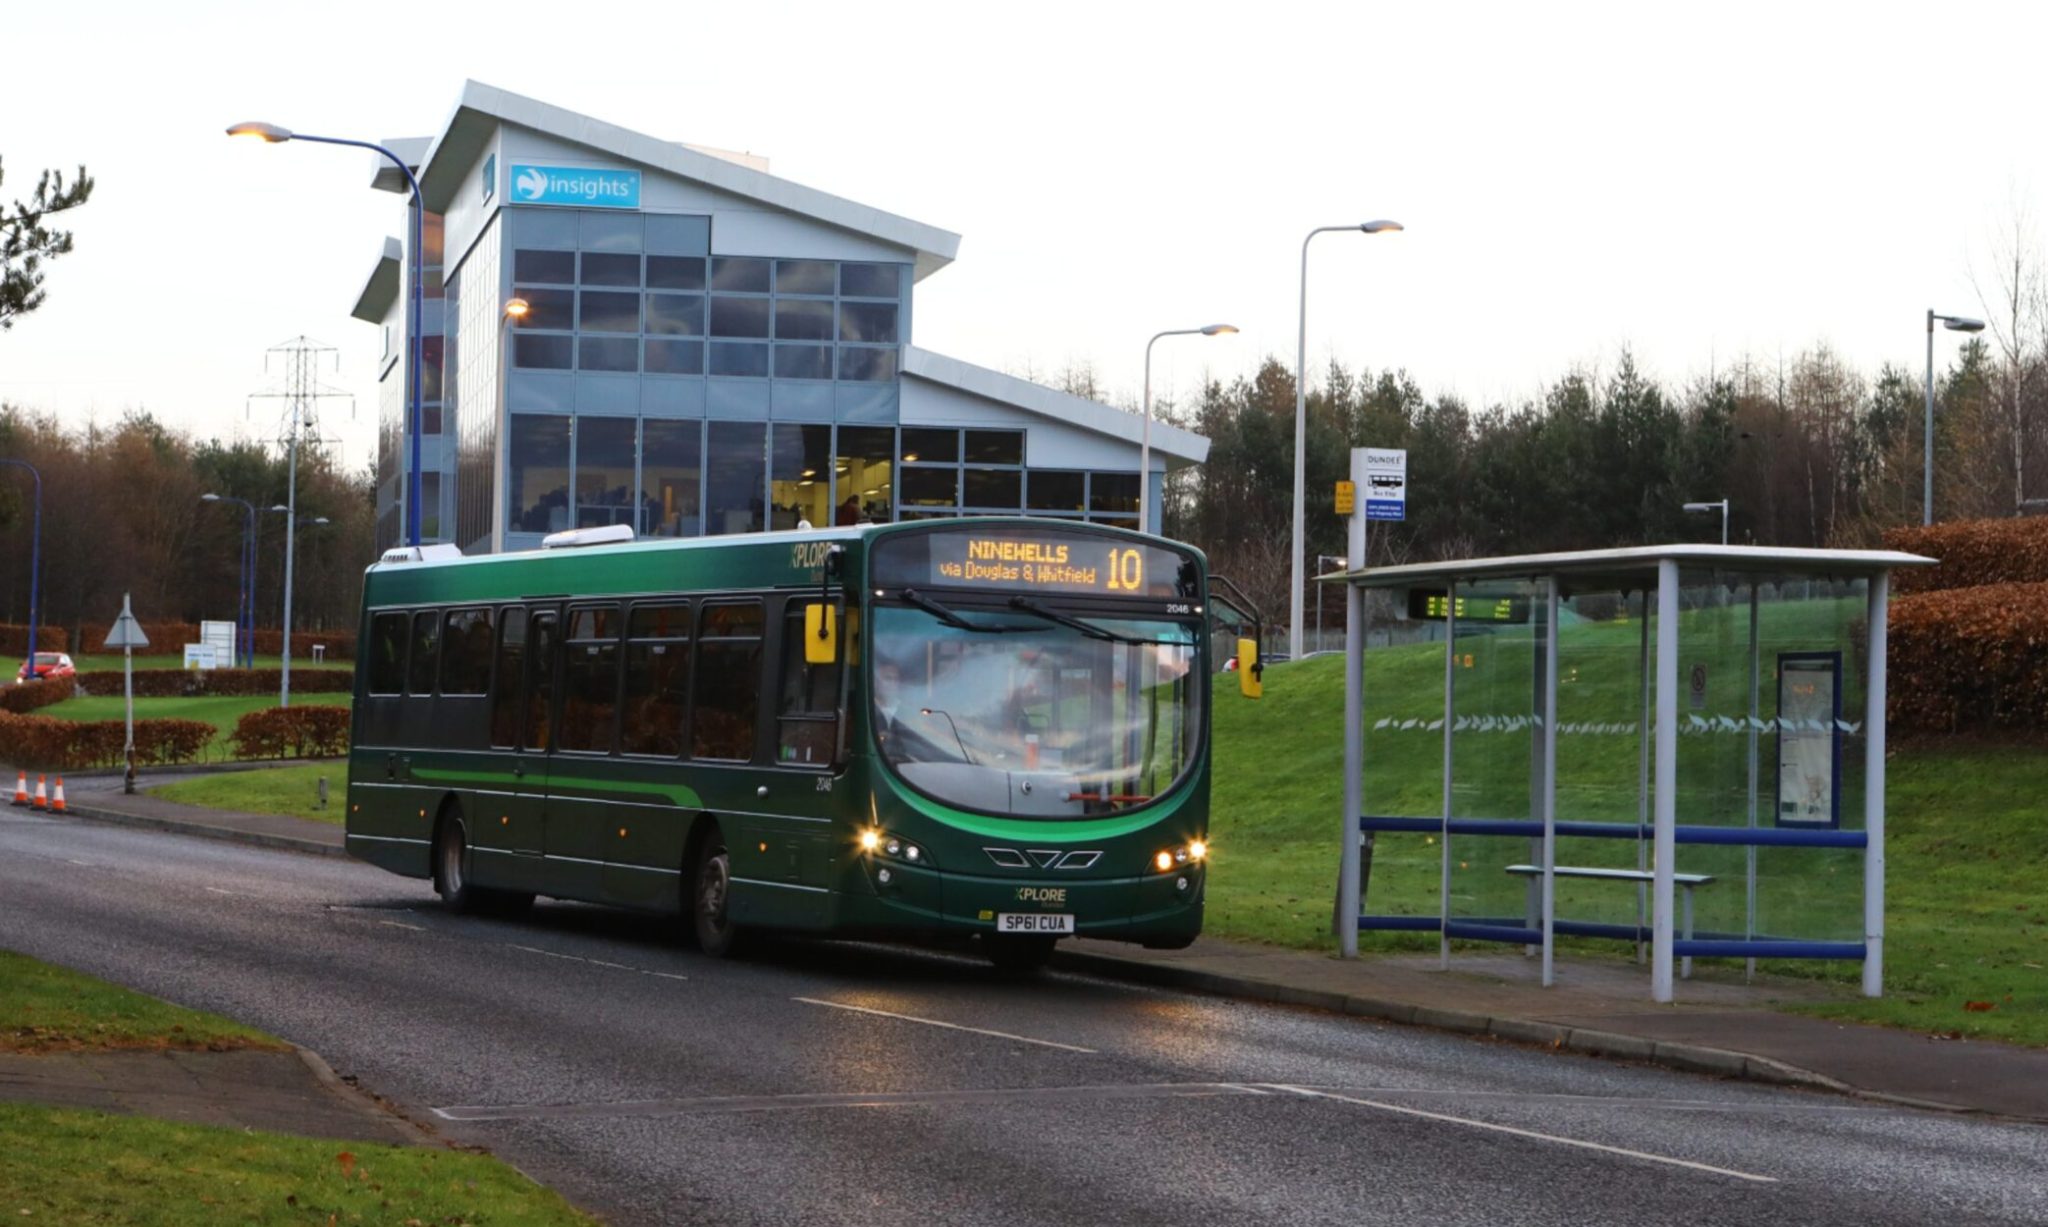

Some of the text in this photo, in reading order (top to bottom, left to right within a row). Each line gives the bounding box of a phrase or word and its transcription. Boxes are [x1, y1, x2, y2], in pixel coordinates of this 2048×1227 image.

[551, 175, 629, 199] insights
[1368, 455, 1401, 464] DUNDEE
[940, 562, 961, 577] via
[966, 561, 1019, 580] Douglas
[1023, 564, 1034, 582] &
[1107, 548, 1142, 590] 10
[1166, 603, 1189, 614] 2046
[1015, 887, 1066, 901] XPLORE
[1040, 915, 1065, 930] CUA
